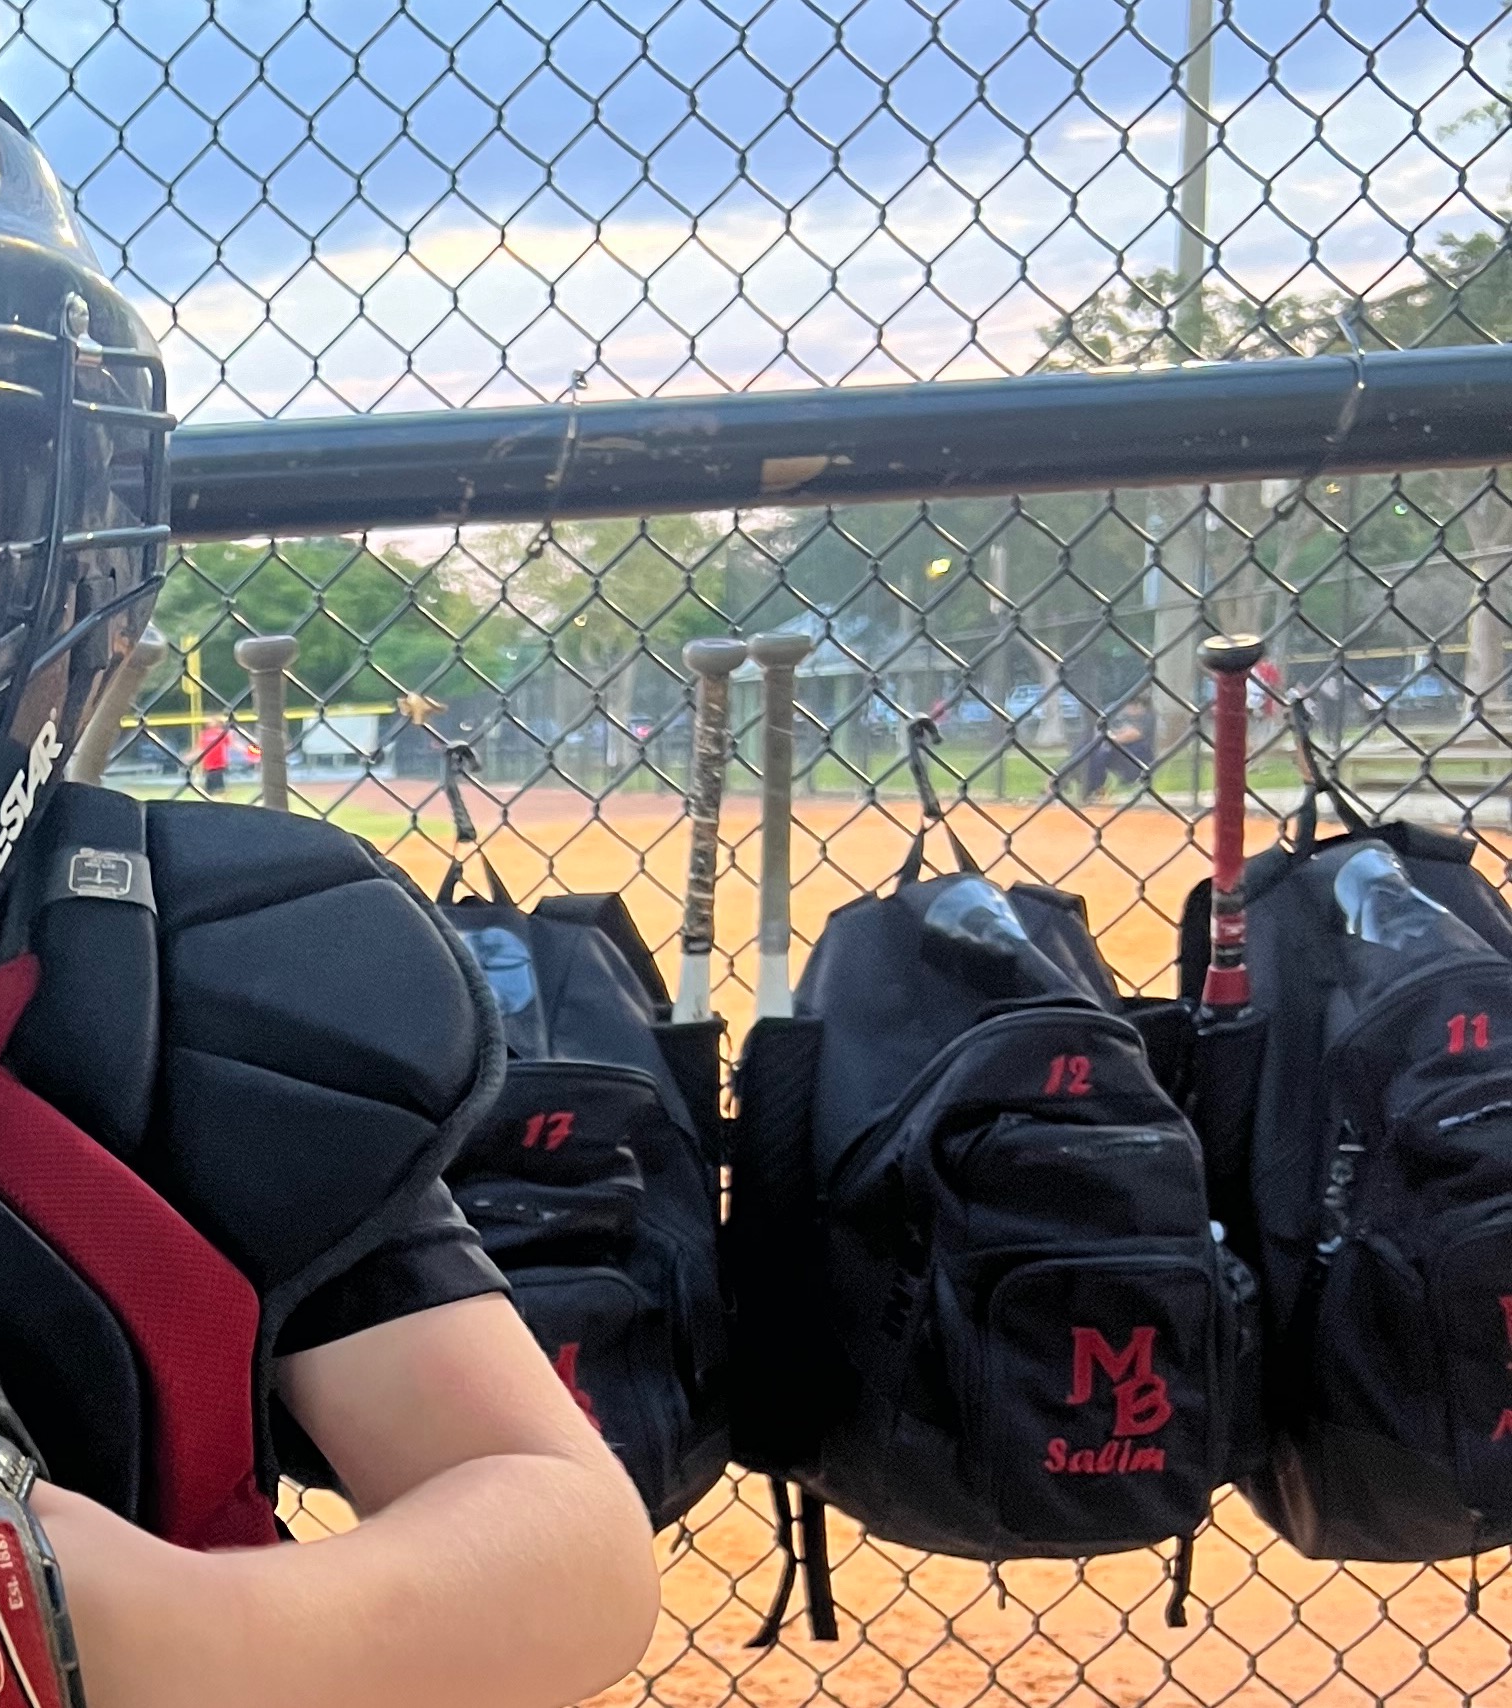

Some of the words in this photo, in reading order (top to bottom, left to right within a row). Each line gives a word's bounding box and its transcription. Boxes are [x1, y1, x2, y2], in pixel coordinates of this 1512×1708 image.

[1446, 1013, 1490, 1055] 11
[1044, 1055, 1093, 1096] 12
[522, 1111, 575, 1150] 17
[1066, 1327, 1173, 1436] MB
